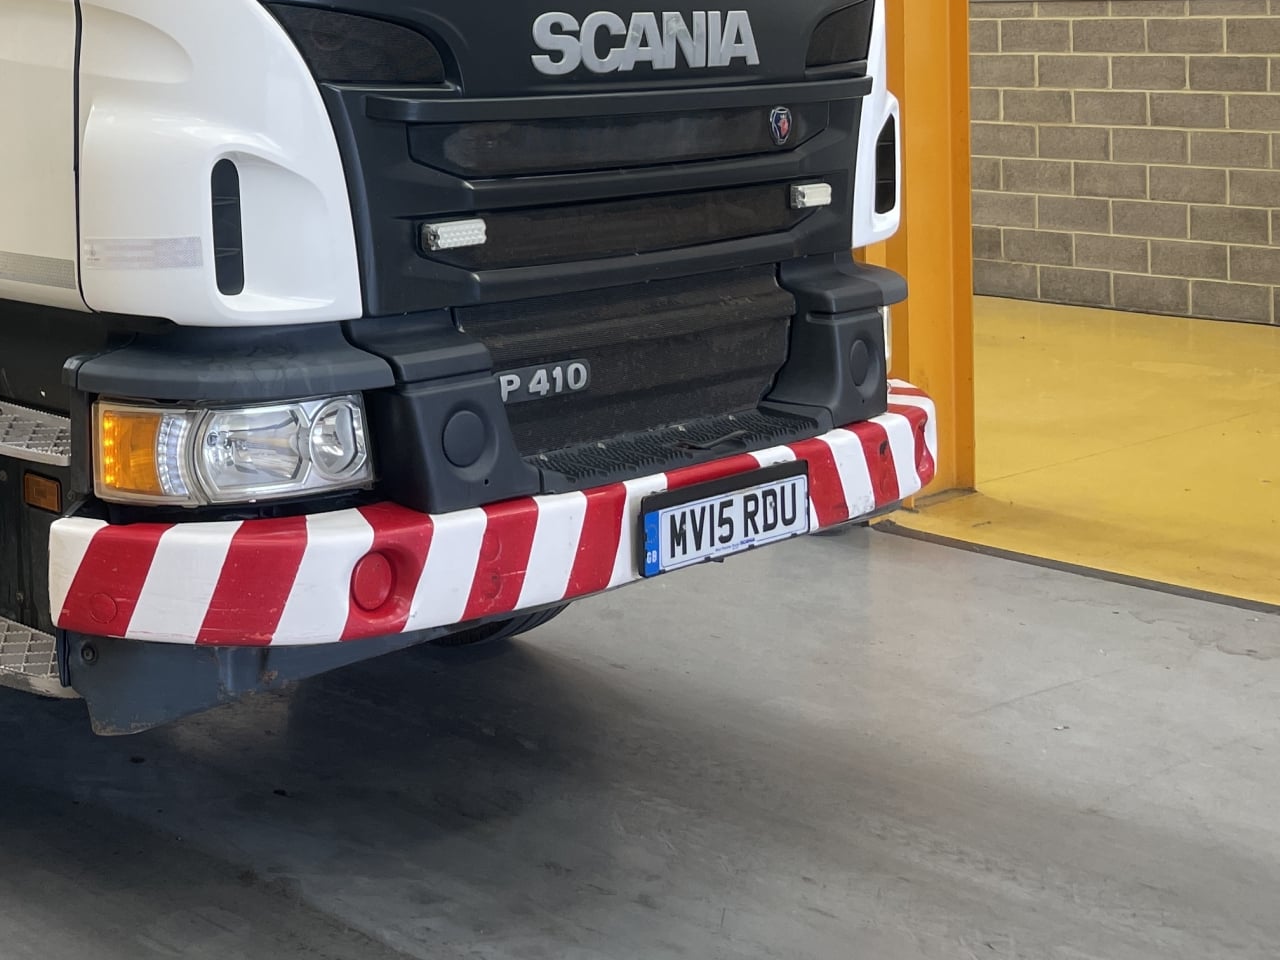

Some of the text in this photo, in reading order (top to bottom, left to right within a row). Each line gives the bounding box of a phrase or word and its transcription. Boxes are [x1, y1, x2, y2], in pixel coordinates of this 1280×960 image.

[531, 10, 760, 75] SCANIA
[500, 363, 587, 402] P 410
[670, 483, 797, 559] MV15 RDU
[646, 549, 657, 564] GB
